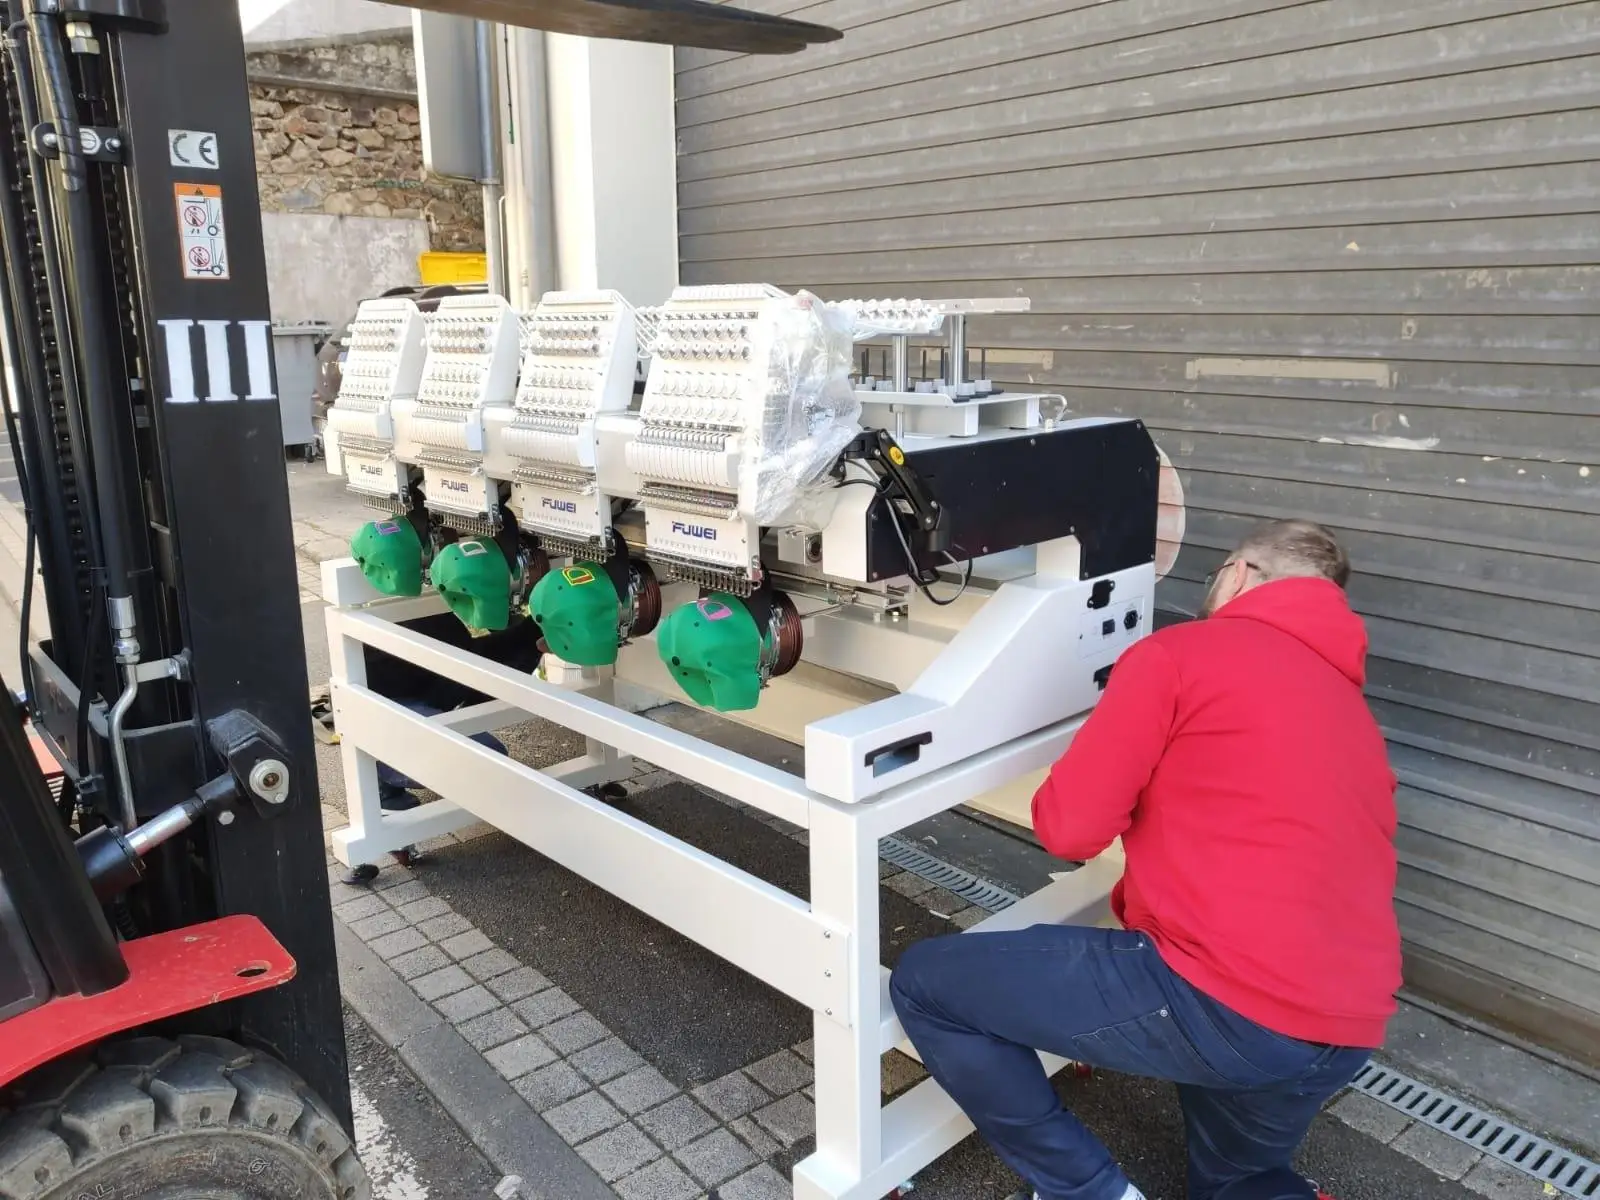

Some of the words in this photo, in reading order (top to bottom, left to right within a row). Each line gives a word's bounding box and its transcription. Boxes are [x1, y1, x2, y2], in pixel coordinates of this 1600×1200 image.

[360, 464, 383, 476] FUWEI
[441, 478, 469, 493] FUWEI
[541, 496, 577, 513] FUWEI
[671, 520, 717, 540] FUWEI
